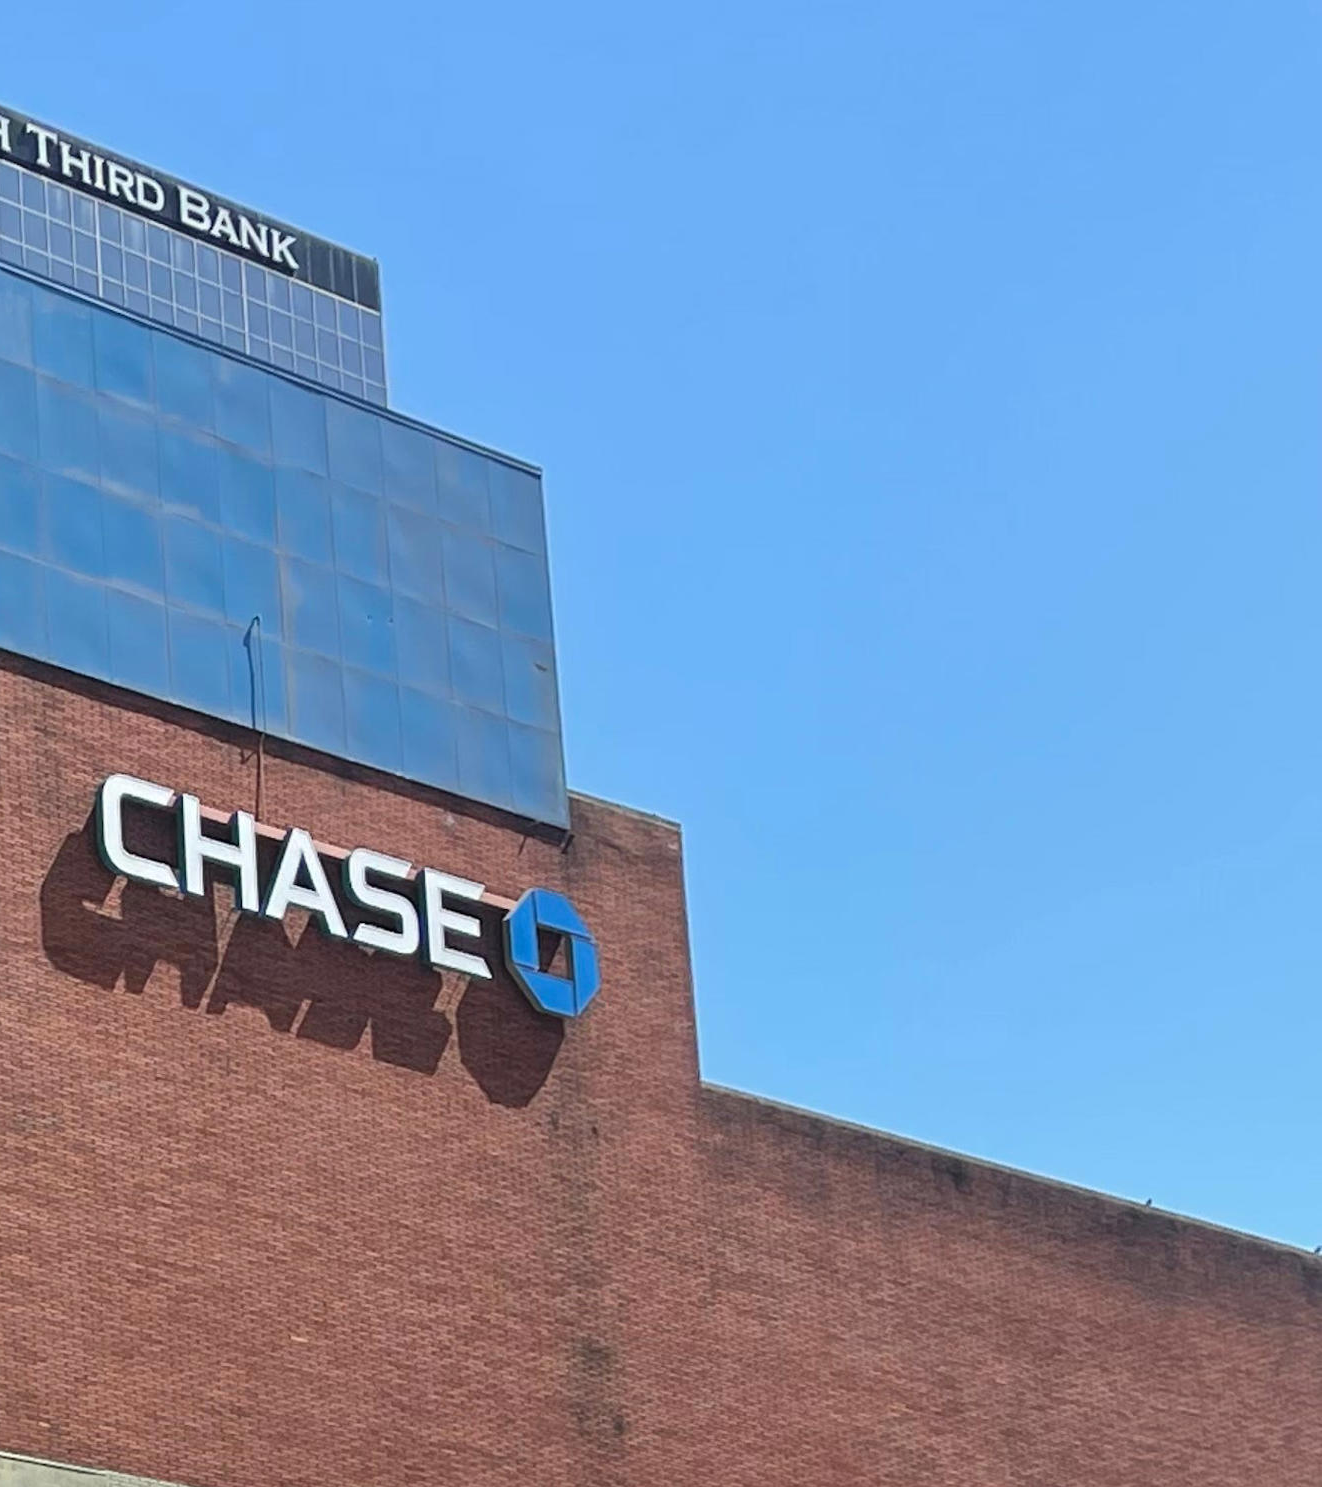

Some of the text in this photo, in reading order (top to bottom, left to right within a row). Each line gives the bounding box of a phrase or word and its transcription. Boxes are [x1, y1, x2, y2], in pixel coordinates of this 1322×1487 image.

[26, 122, 165, 214] THIRD
[176, 184, 300, 270] BANK
[98, 773, 493, 980] CHASE
